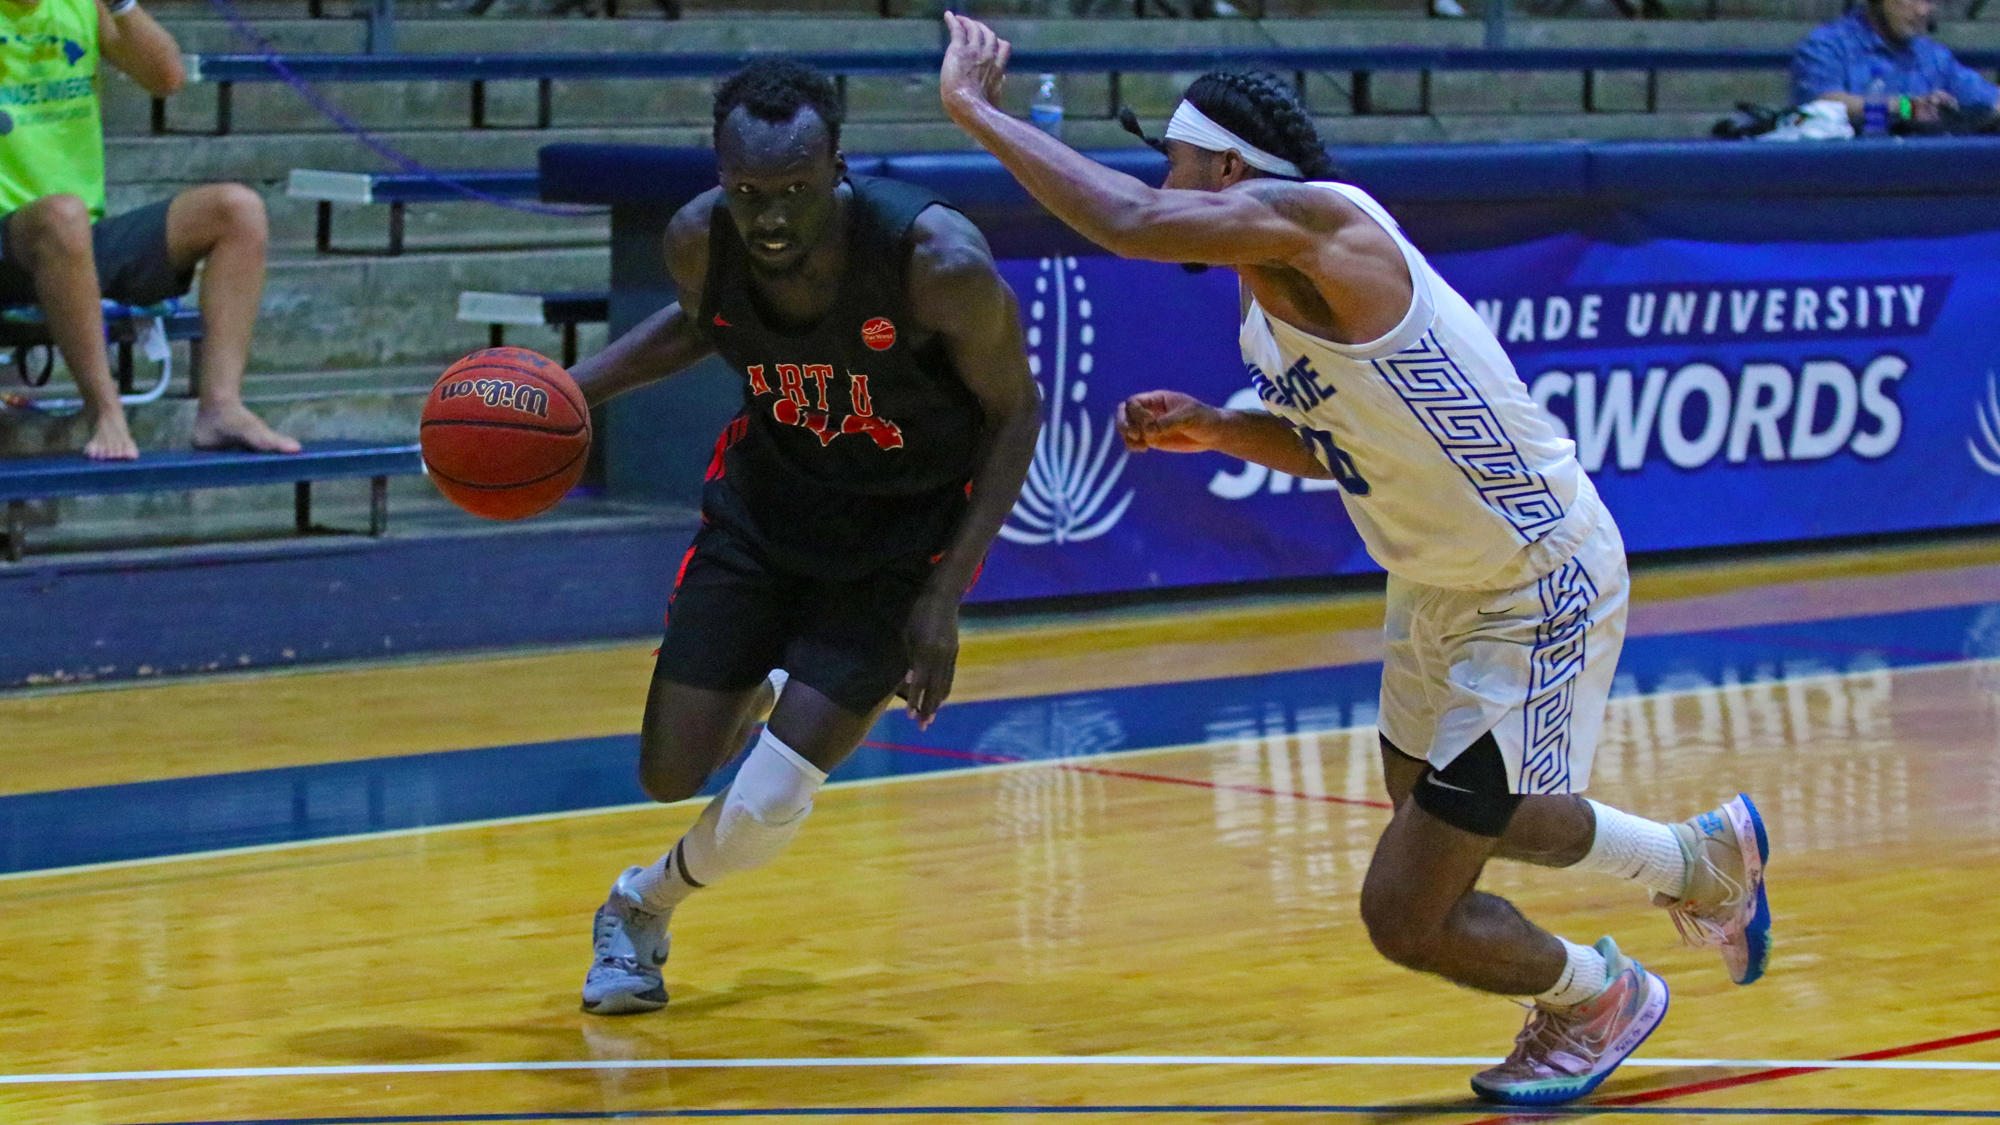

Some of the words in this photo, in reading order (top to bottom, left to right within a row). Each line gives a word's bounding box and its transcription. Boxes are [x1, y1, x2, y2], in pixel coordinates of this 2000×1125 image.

[1475, 293, 1603, 342] NADE
[1626, 284, 1925, 337] UNIVERSITY
[440, 379, 549, 419] Wilson
[747, 363, 834, 411] ART
[1530, 355, 1908, 472] SWORDS
